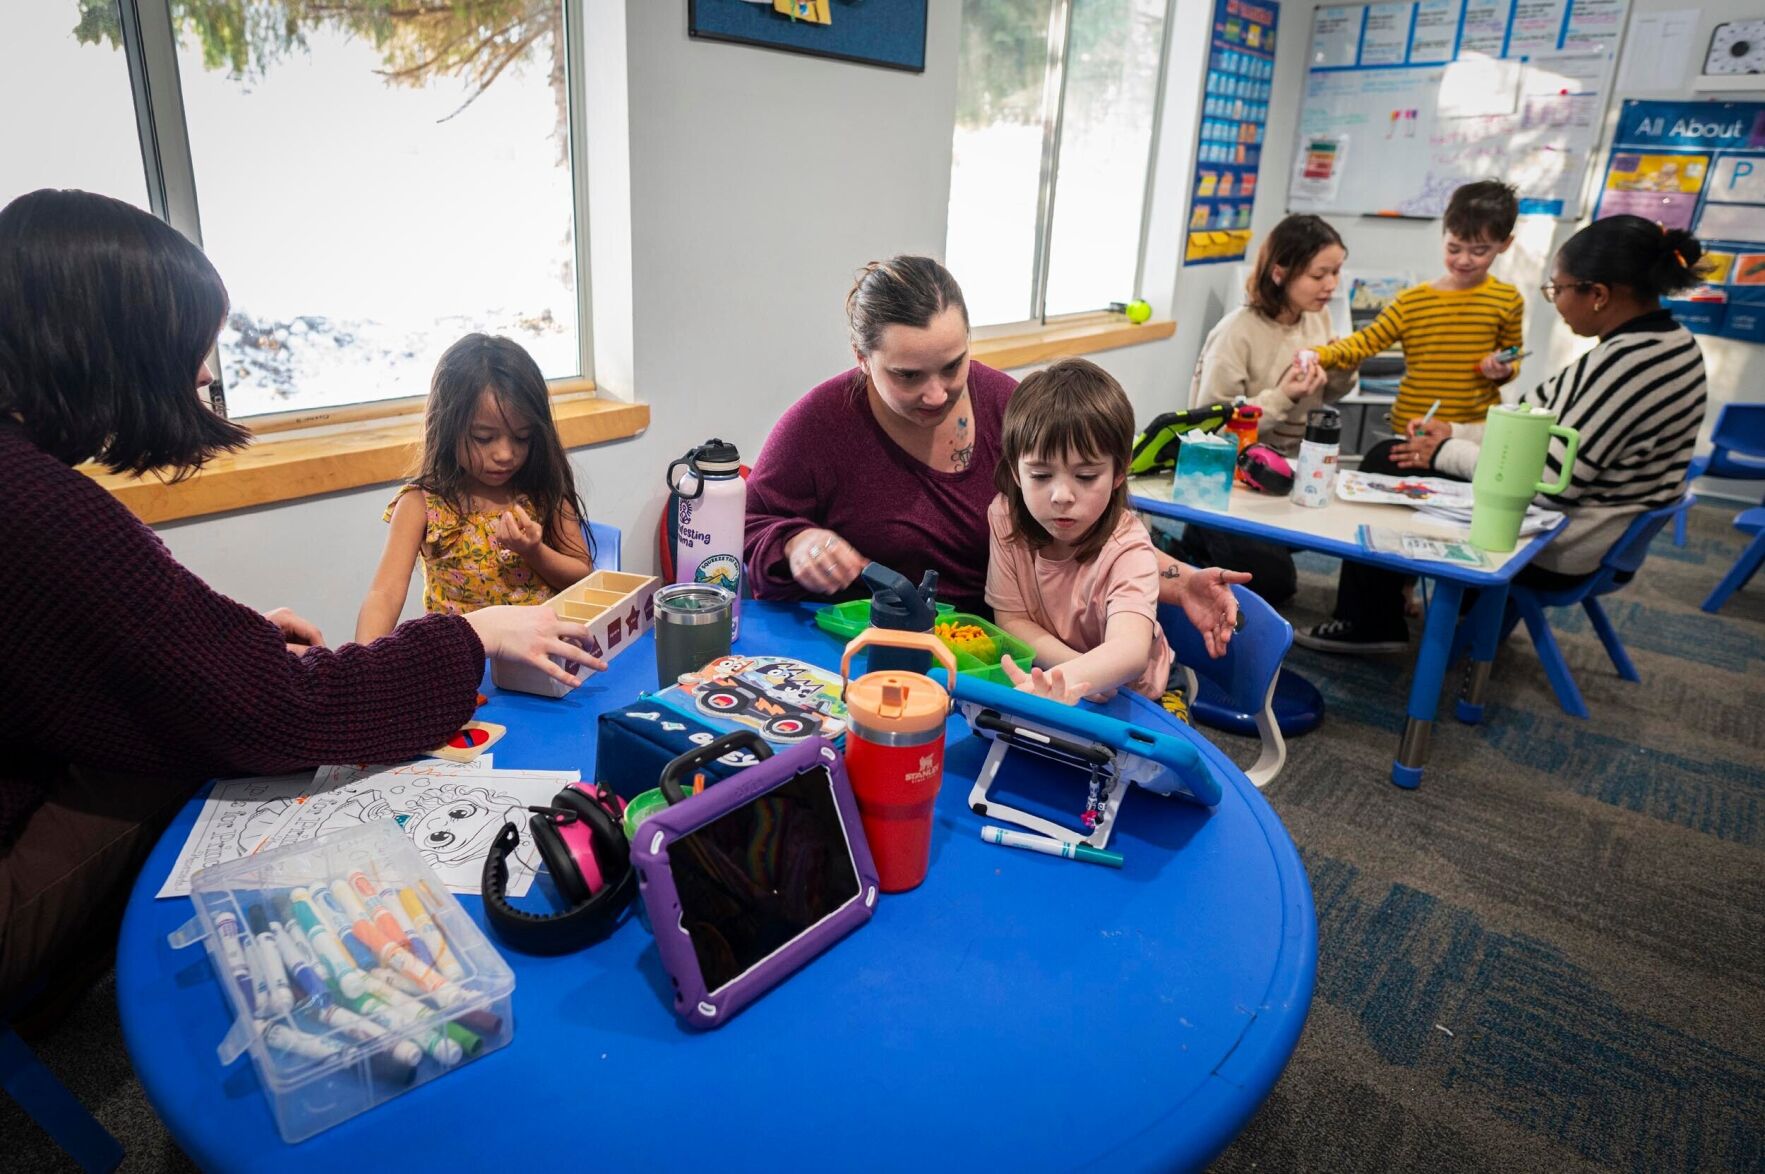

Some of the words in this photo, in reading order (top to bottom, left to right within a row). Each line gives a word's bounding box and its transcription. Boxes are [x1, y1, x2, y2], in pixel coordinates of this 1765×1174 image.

[1634, 117, 1665, 137] All
[1668, 117, 1744, 138] About
[1728, 161, 1754, 190] P
[905, 763, 940, 781] STANLEY
[203, 829, 238, 869] Princ
